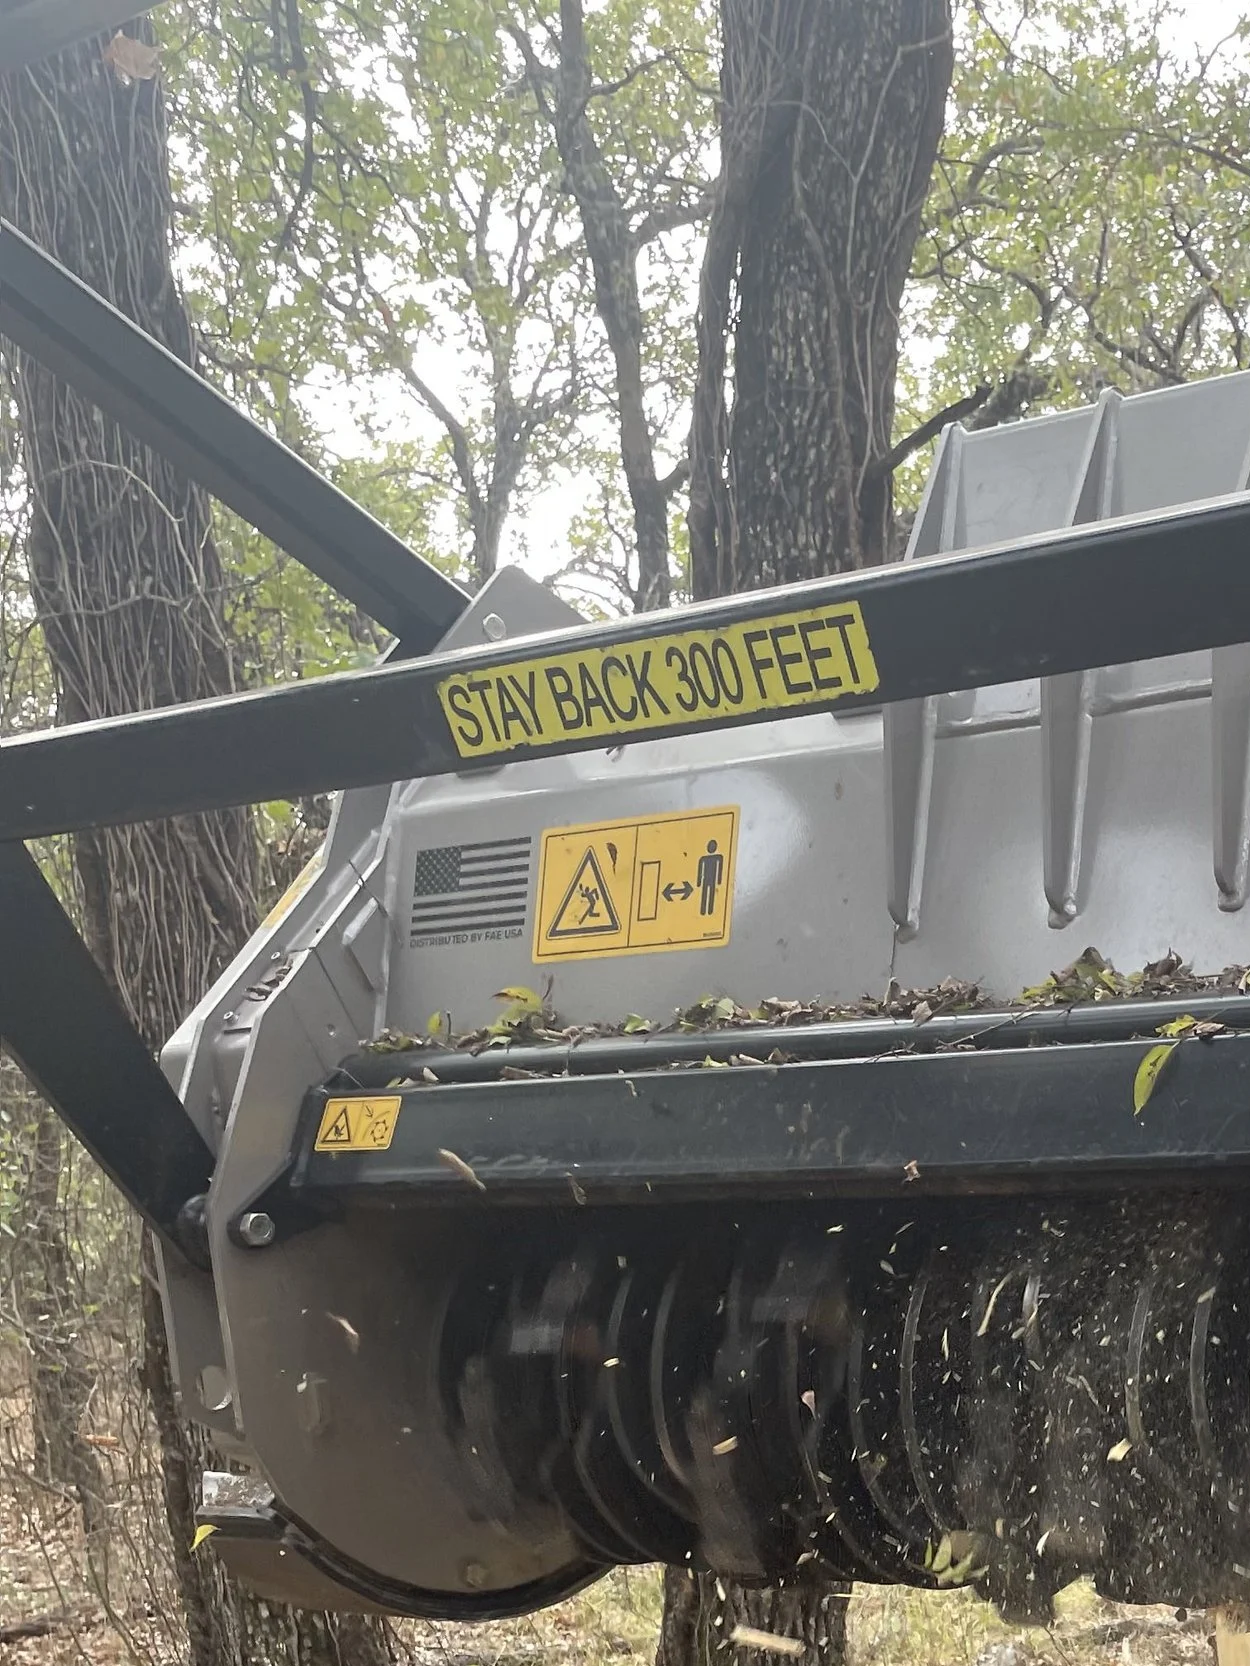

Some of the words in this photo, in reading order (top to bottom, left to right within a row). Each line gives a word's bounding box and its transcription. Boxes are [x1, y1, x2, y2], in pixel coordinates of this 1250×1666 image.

[448, 671, 543, 747] STAY
[544, 650, 671, 730] BACK
[665, 637, 744, 712] 300
[743, 614, 861, 699] FEET
[409, 934, 468, 948] DISTRIBUTED
[471, 932, 482, 942] BY
[485, 930, 502, 941] FAE
[504, 927, 523, 939] USA
